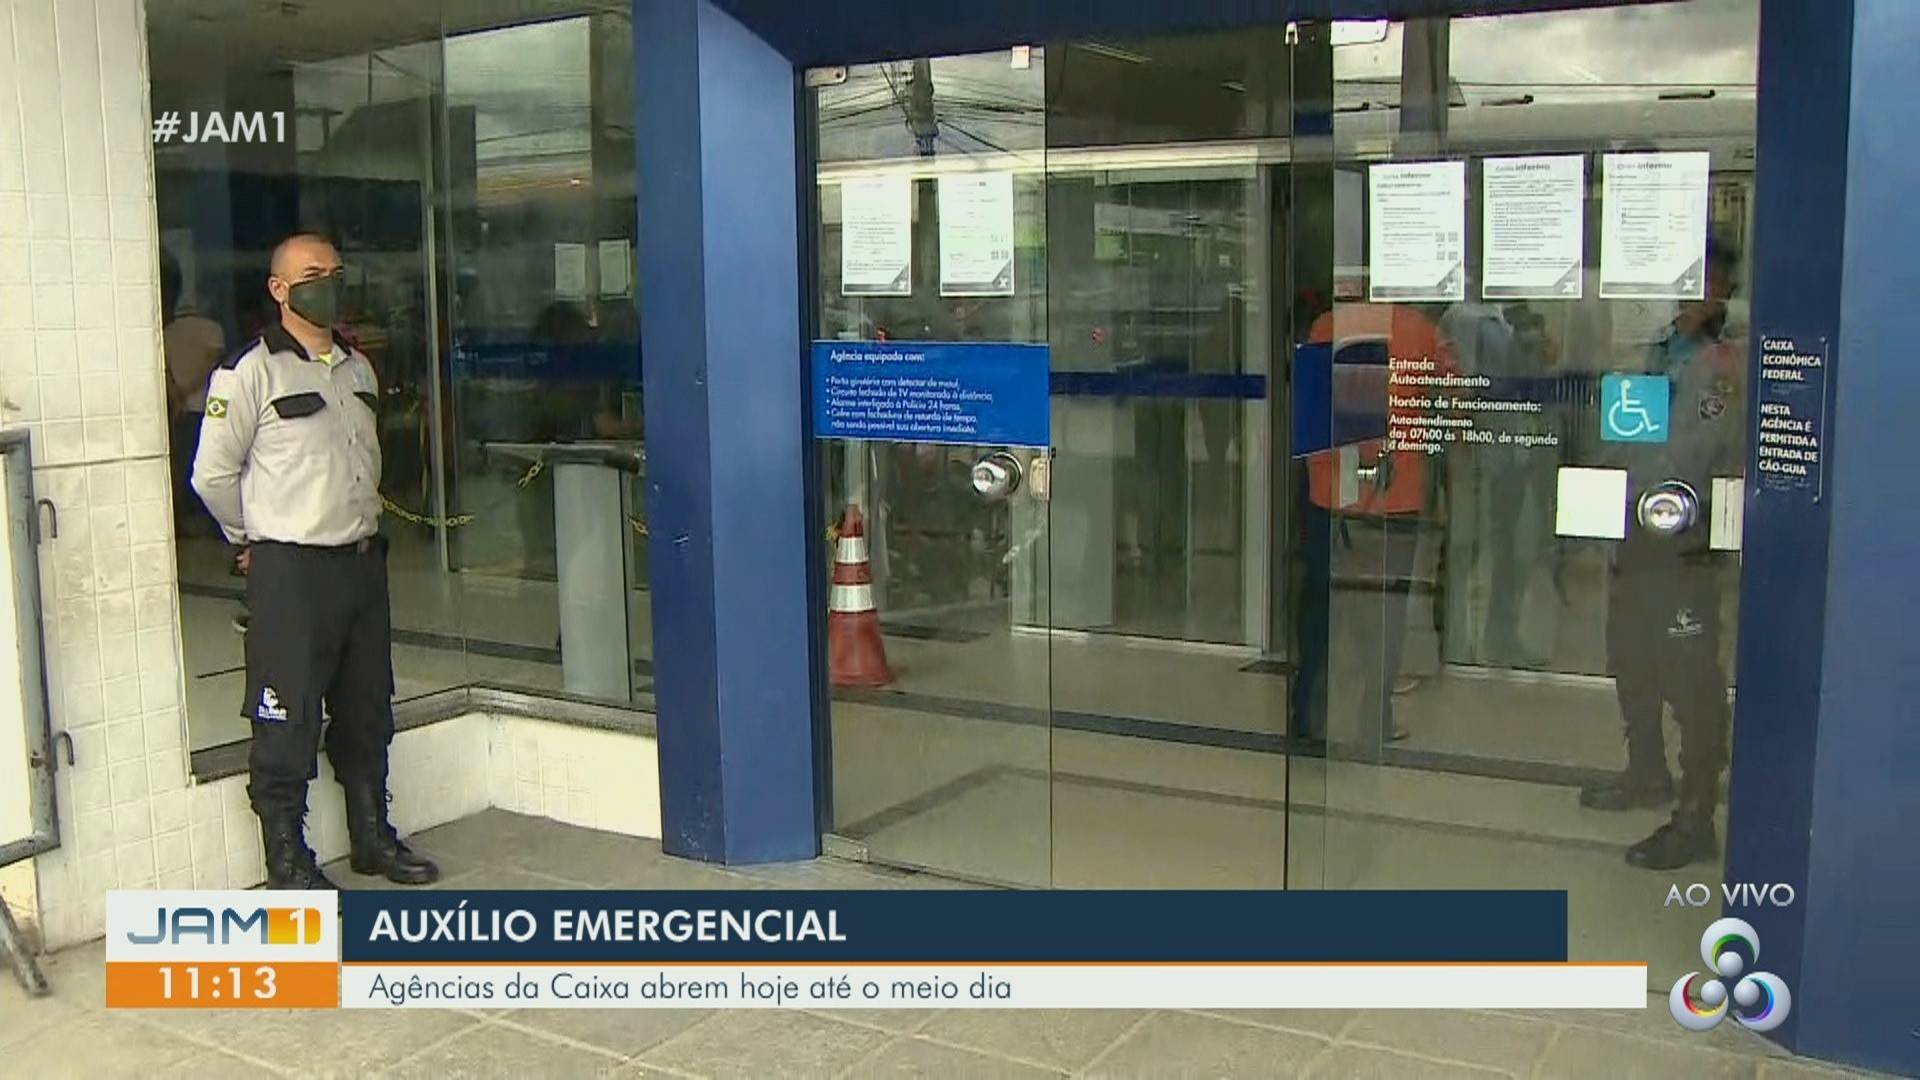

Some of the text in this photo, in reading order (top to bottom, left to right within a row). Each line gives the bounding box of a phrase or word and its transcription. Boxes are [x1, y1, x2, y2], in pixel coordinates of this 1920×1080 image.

[1763, 339, 1794, 351] CAIXA
[864, 350, 903, 364] equipada
[904, 352, 925, 361] com:
[1762, 353, 1822, 367] ECONÔMICA
[1389, 358, 1435, 371] Entrada
[1389, 373, 1491, 387] Autoatendimento
[1762, 369, 1805, 381] FEDERAL
[899, 387, 909, 397] TV
[928, 400, 938, 409] 24
[1389, 394, 1543, 412] Horário de Funcionamento:
[1760, 403, 1791, 416] NESTA
[1389, 414, 1473, 427] Autoatendimento
[1761, 416, 1803, 431] AGÊNCIA
[1409, 428, 1443, 440] 07h00
[1461, 430, 1496, 444] 18h00,
[1498, 431, 1512, 443] de
[1513, 432, 1558, 447] segunda
[1760, 431, 1818, 447] PERMITIDA A
[1397, 438, 1444, 455] domingo.
[1759, 445, 1819, 462] ENTRADA DE
[1759, 459, 1807, 475] CÃO-GUIA
